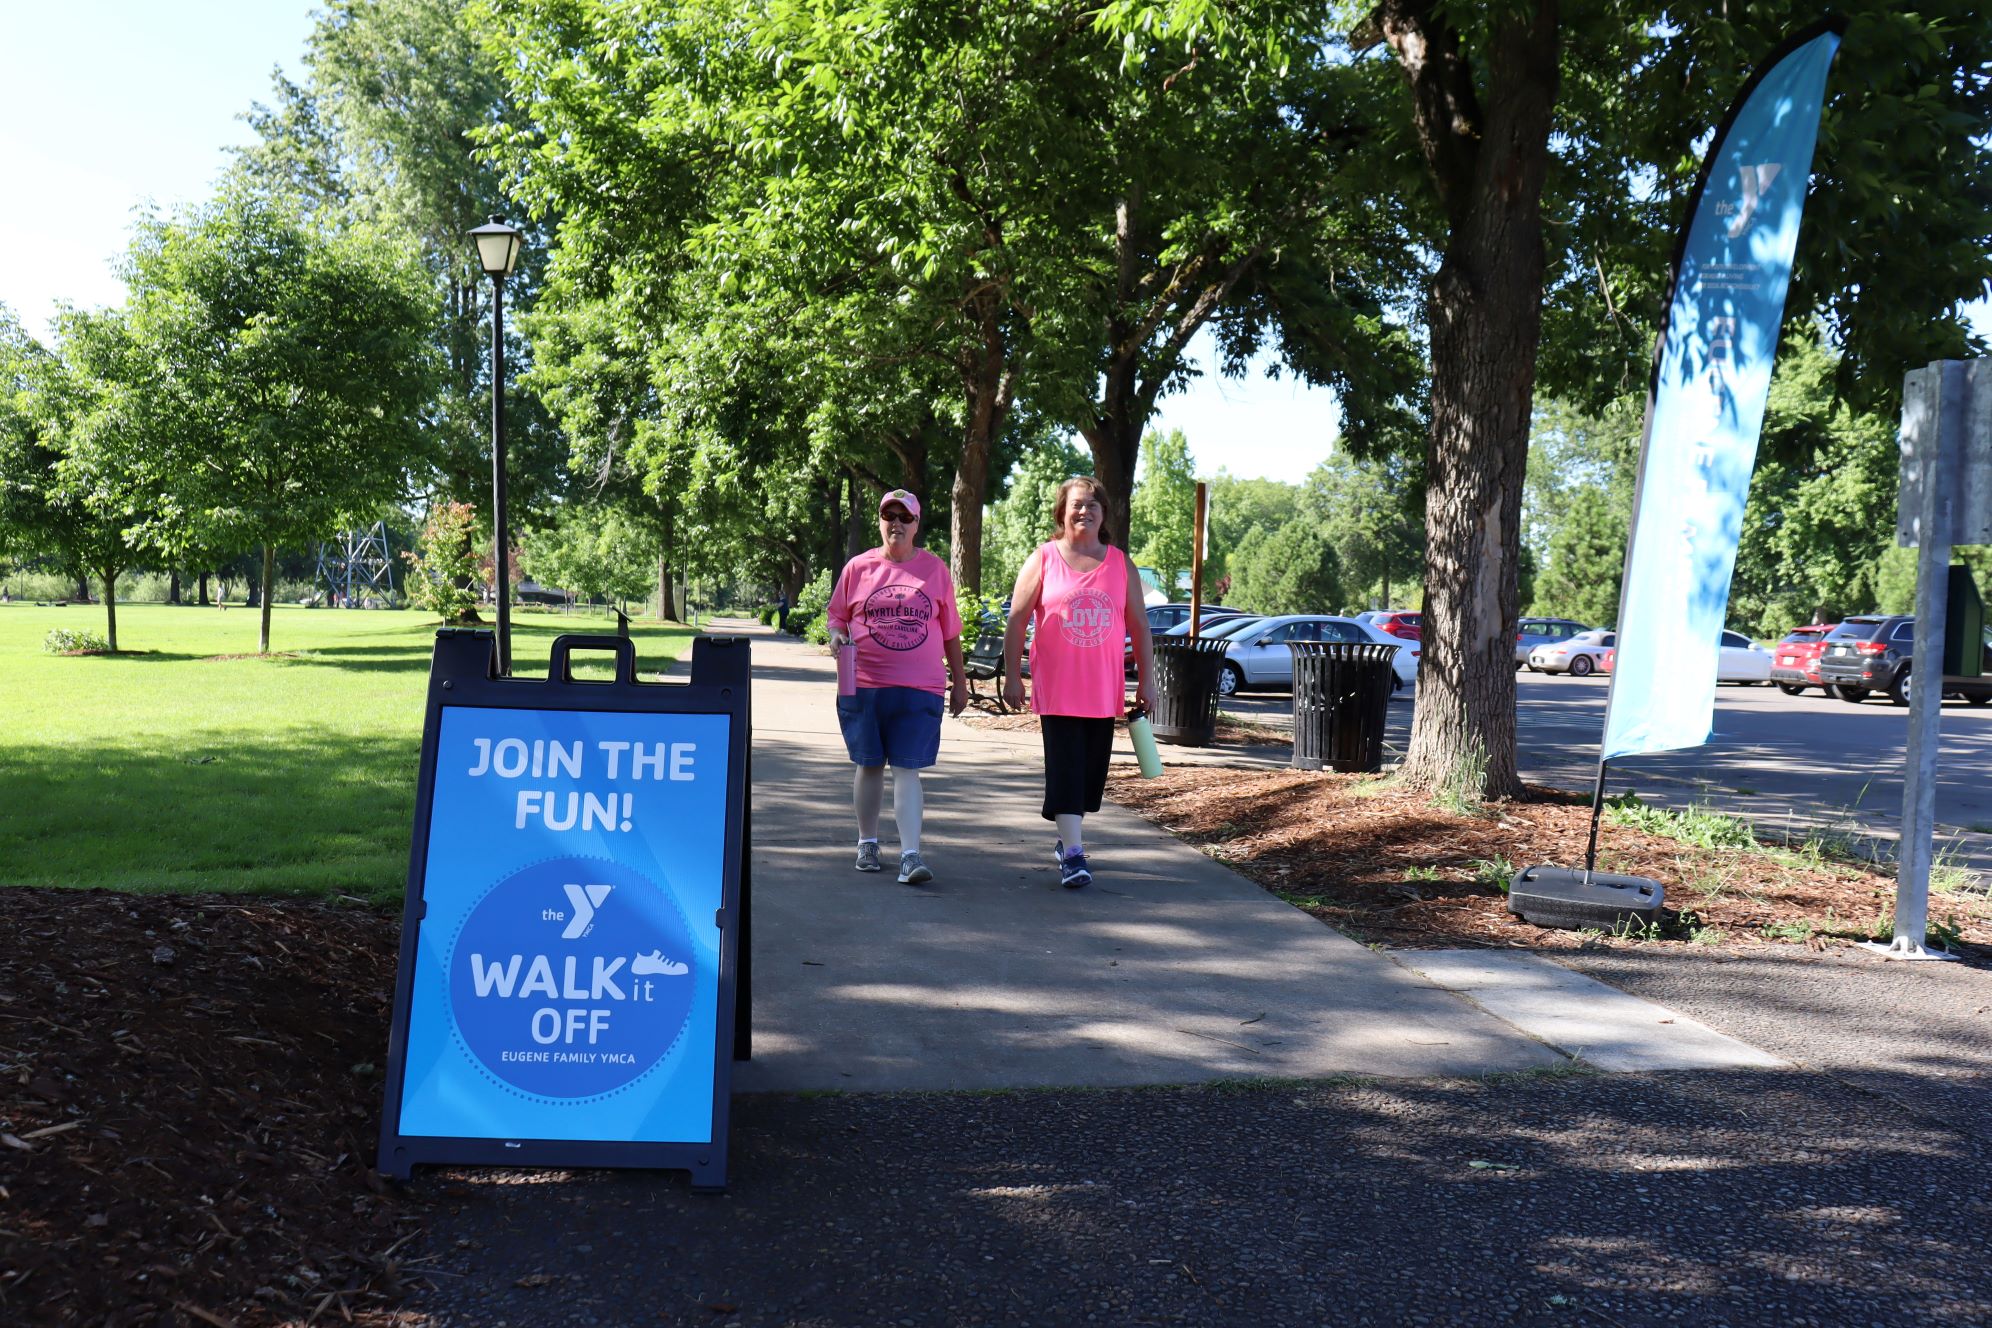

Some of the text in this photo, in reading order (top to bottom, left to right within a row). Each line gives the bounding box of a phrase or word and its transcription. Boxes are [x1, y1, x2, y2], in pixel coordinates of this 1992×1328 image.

[1715, 200, 1733, 215] the
[868, 607, 929, 621] MYRTLE BEACH
[1062, 608, 1111, 628] LOVE
[468, 738, 697, 781] JOIN THE
[515, 790, 633, 832] FUN!
[542, 908, 564, 921] the
[470, 953, 654, 1002] WALK it
[531, 1008, 611, 1045] OFF
[502, 1051, 636, 1064] EUGENE FAMILY YMCA
